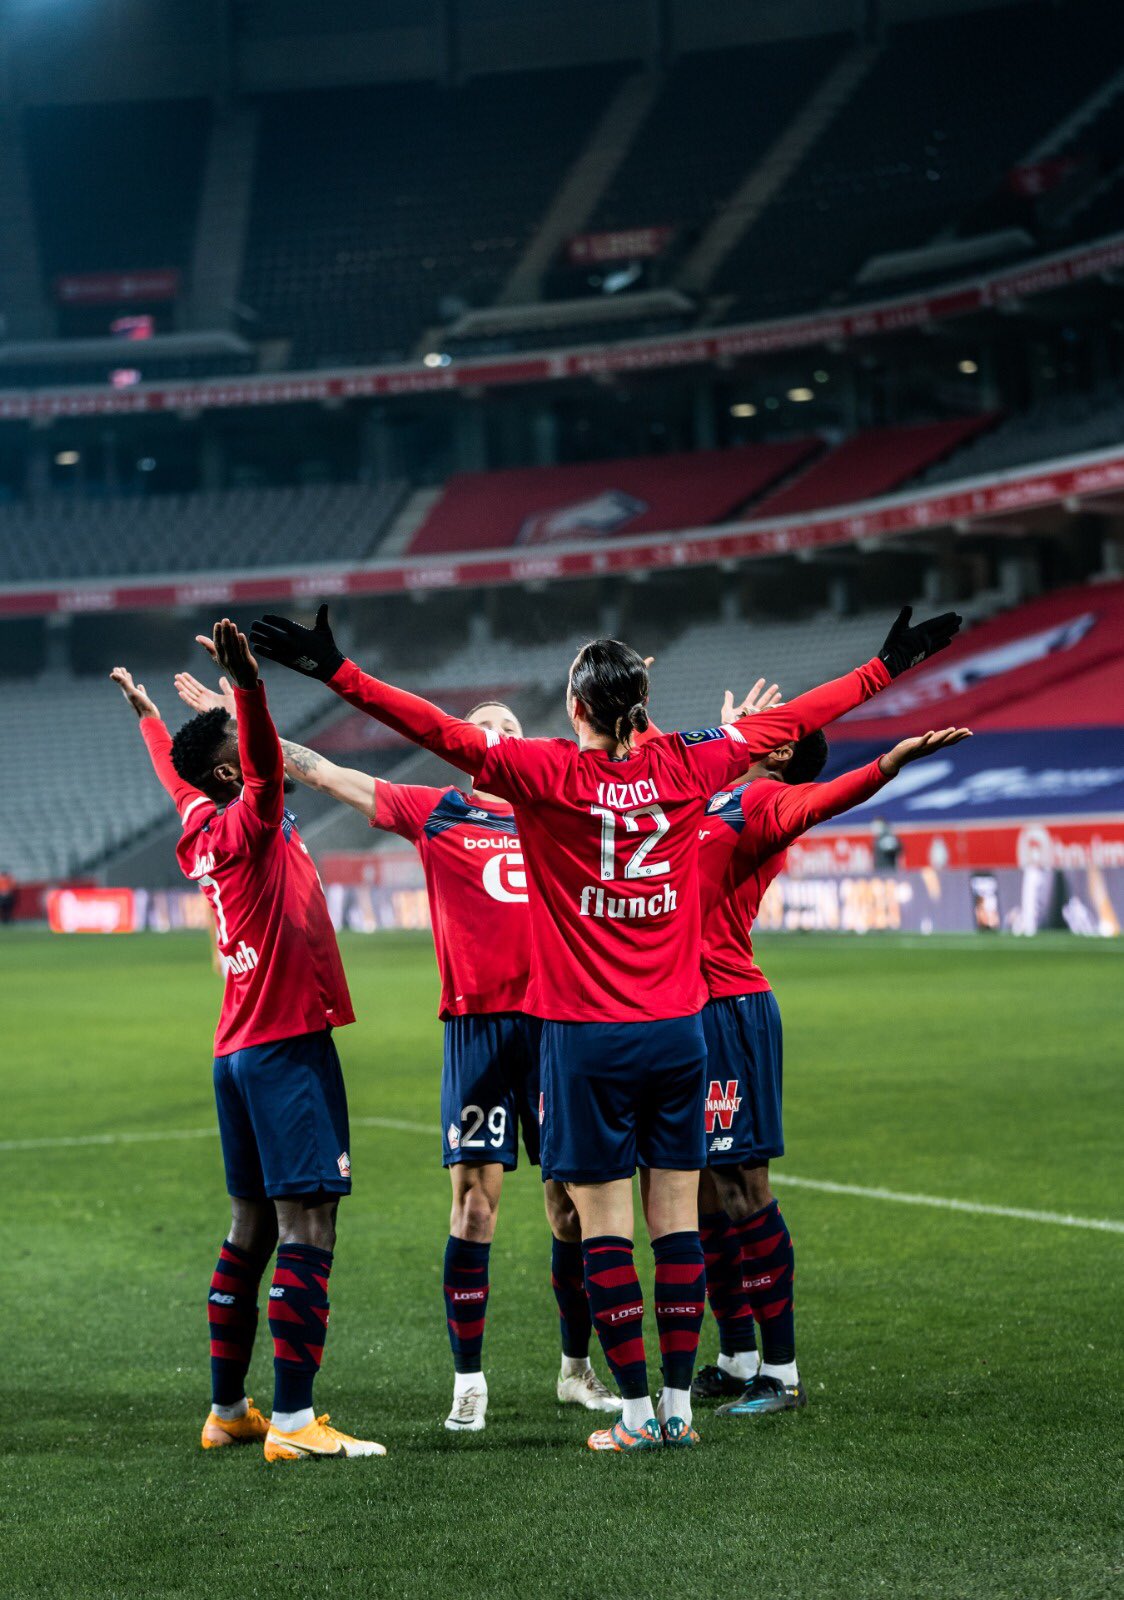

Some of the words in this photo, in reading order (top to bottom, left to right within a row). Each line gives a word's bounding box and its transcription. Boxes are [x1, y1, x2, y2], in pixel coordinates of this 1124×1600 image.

[597, 778, 659, 809] YAZICI
[590, 803, 671, 881] 12
[579, 883, 677, 919] flunch
[461, 1104, 507, 1148] 29
[454, 1291, 484, 1300] LOSC
[658, 1306, 696, 1314] LOSC
[611, 1305, 643, 1322] LOSC
